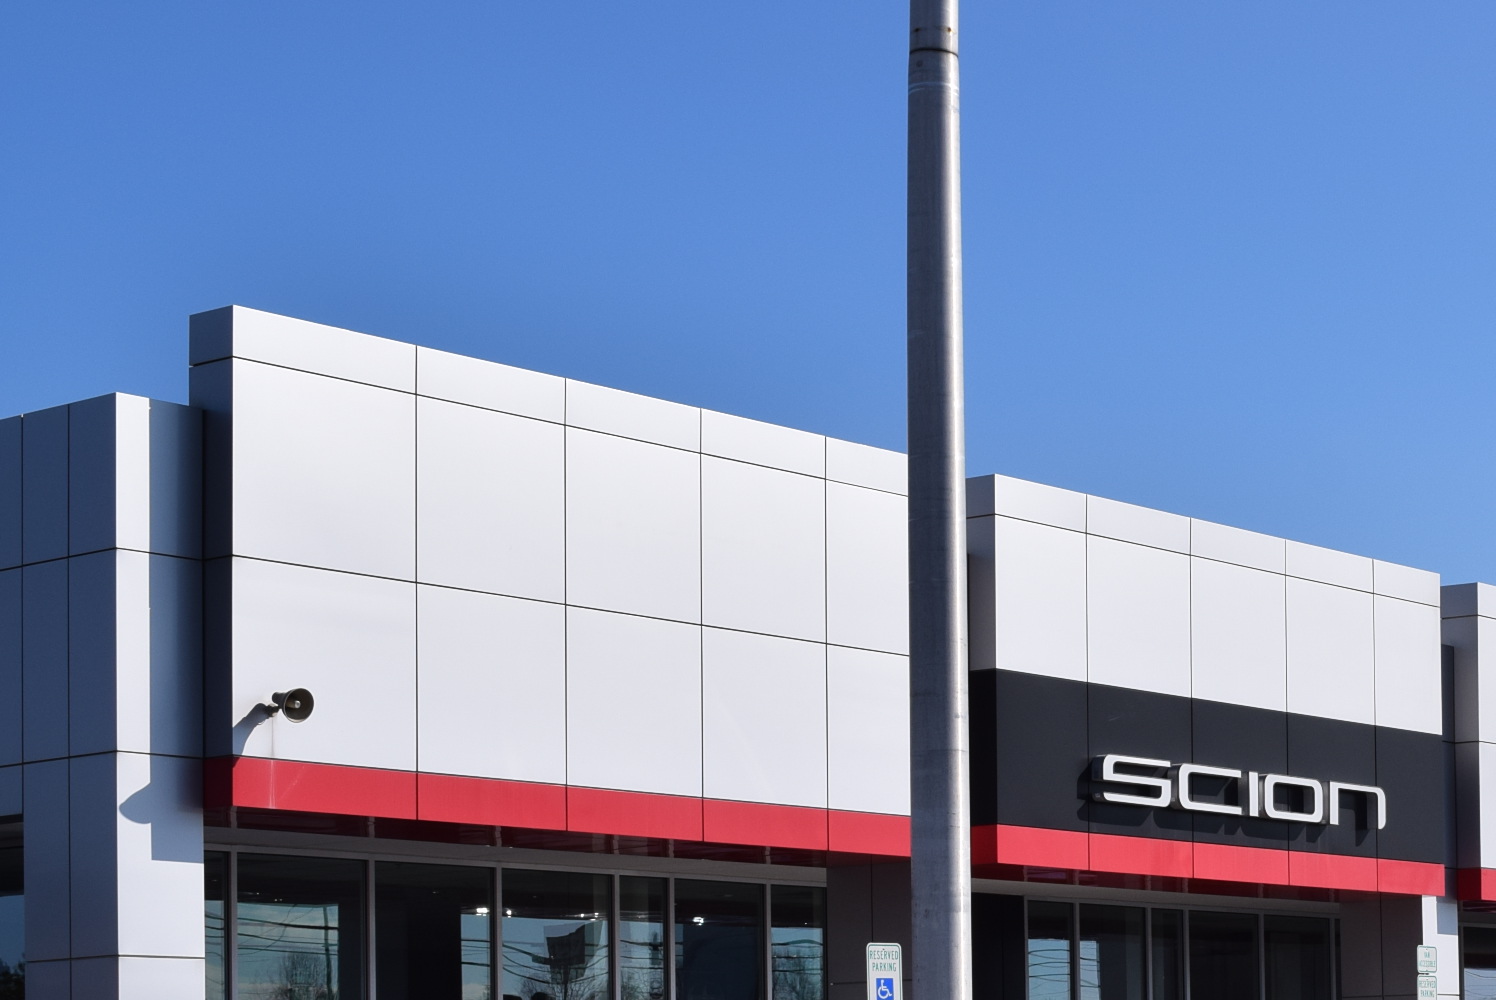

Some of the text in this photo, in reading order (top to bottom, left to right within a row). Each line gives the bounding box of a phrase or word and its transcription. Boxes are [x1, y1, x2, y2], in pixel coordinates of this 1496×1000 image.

[1094, 753, 1387, 830] SCION
[869, 950, 899, 960] RESERVED
[872, 962, 897, 972] PARKING
[1419, 980, 1436, 988] RESERVED
[1420, 989, 1435, 998] PARKING
